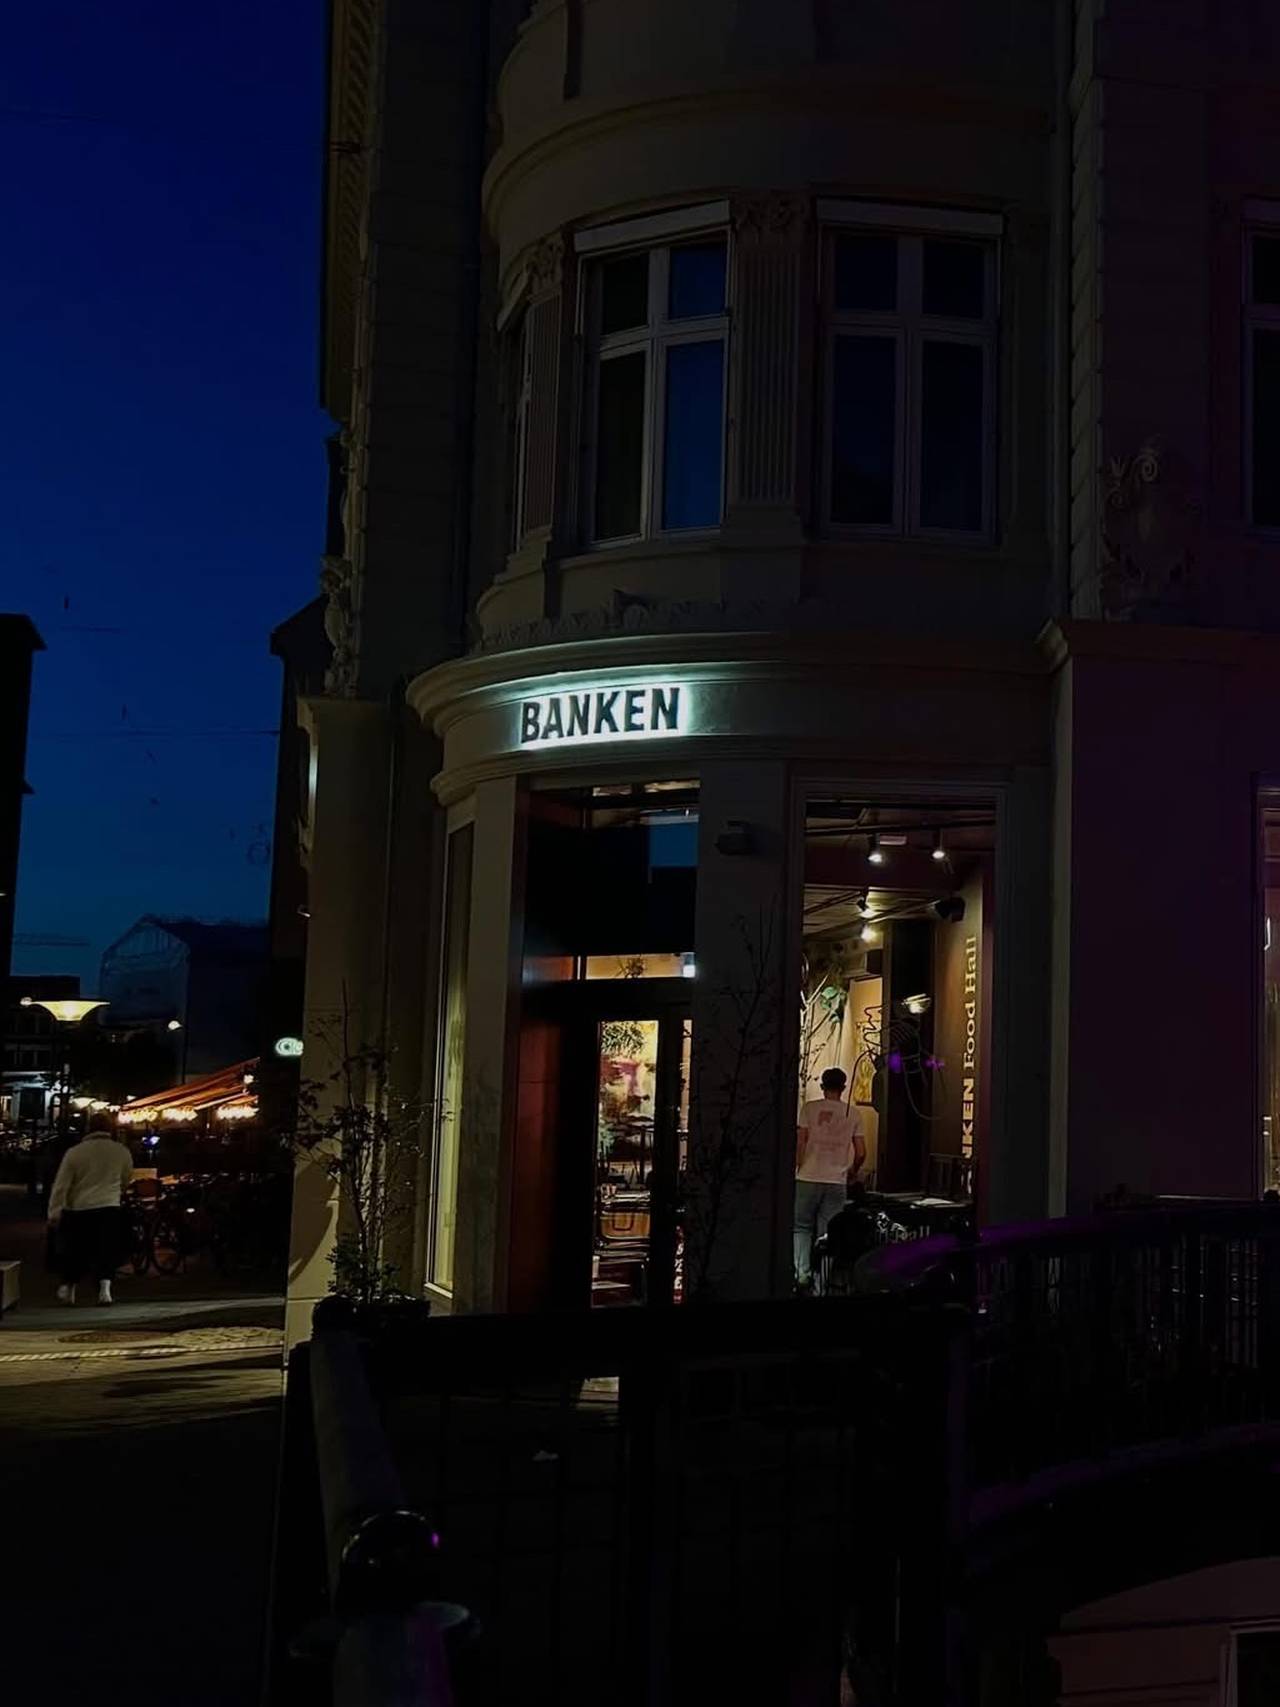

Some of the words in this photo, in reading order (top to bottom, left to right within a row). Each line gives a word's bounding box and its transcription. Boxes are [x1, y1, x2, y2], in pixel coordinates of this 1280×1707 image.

[520, 687, 680, 743] BANKEN
[964, 936, 977, 995] Hall
[963, 999, 976, 1071] Food
